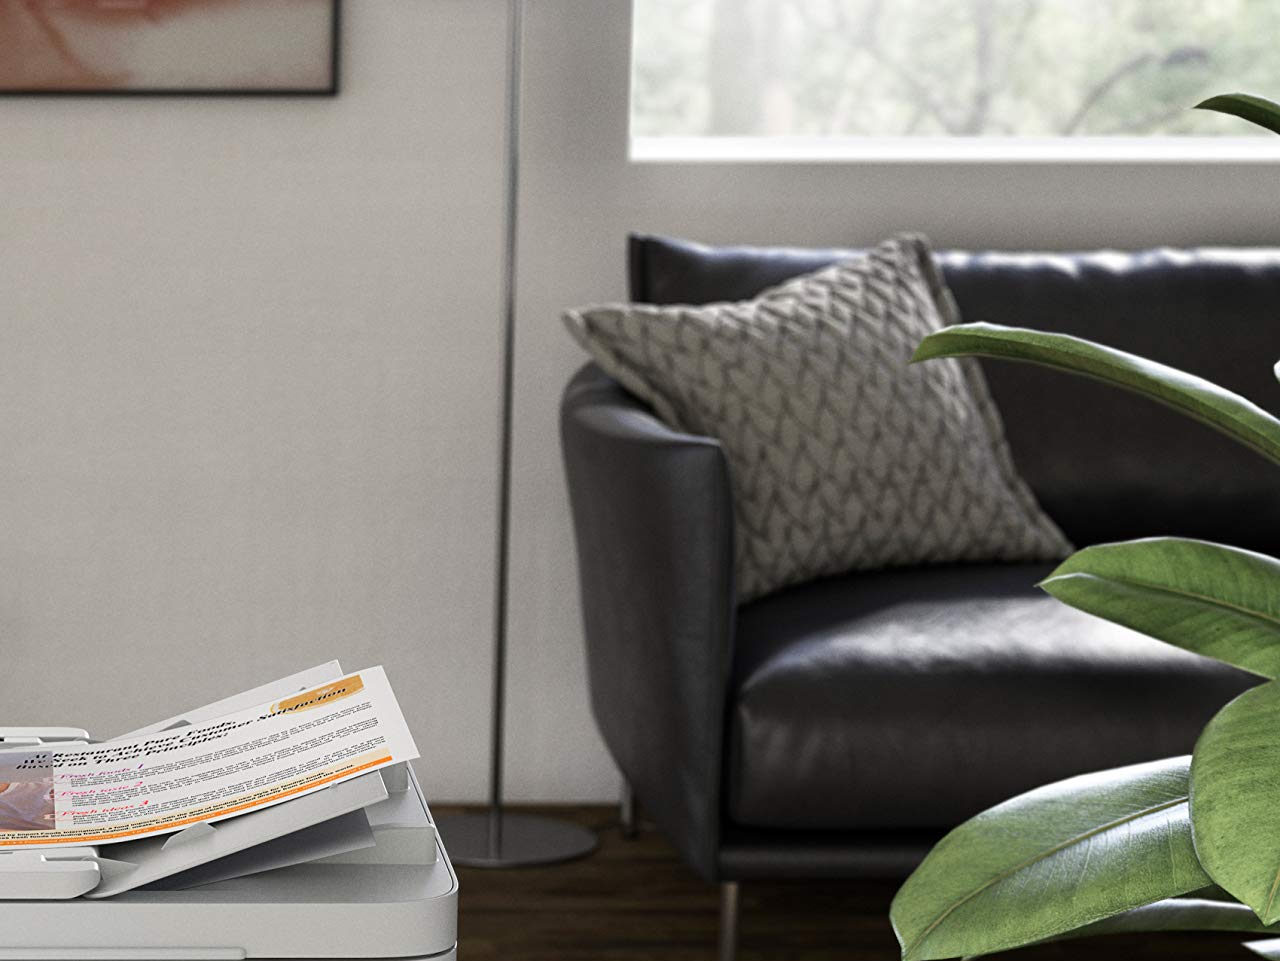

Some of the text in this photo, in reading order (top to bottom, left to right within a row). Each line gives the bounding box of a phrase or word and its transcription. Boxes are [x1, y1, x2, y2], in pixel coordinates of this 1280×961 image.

[112, 742, 174, 757] Achieve
[179, 720, 253, 743] Customer
[257, 688, 346, 722] Satisfaction
[53, 744, 139, 758] Restaurant
[144, 735, 180, 746] Pure
[96, 754, 140, 764] Three
